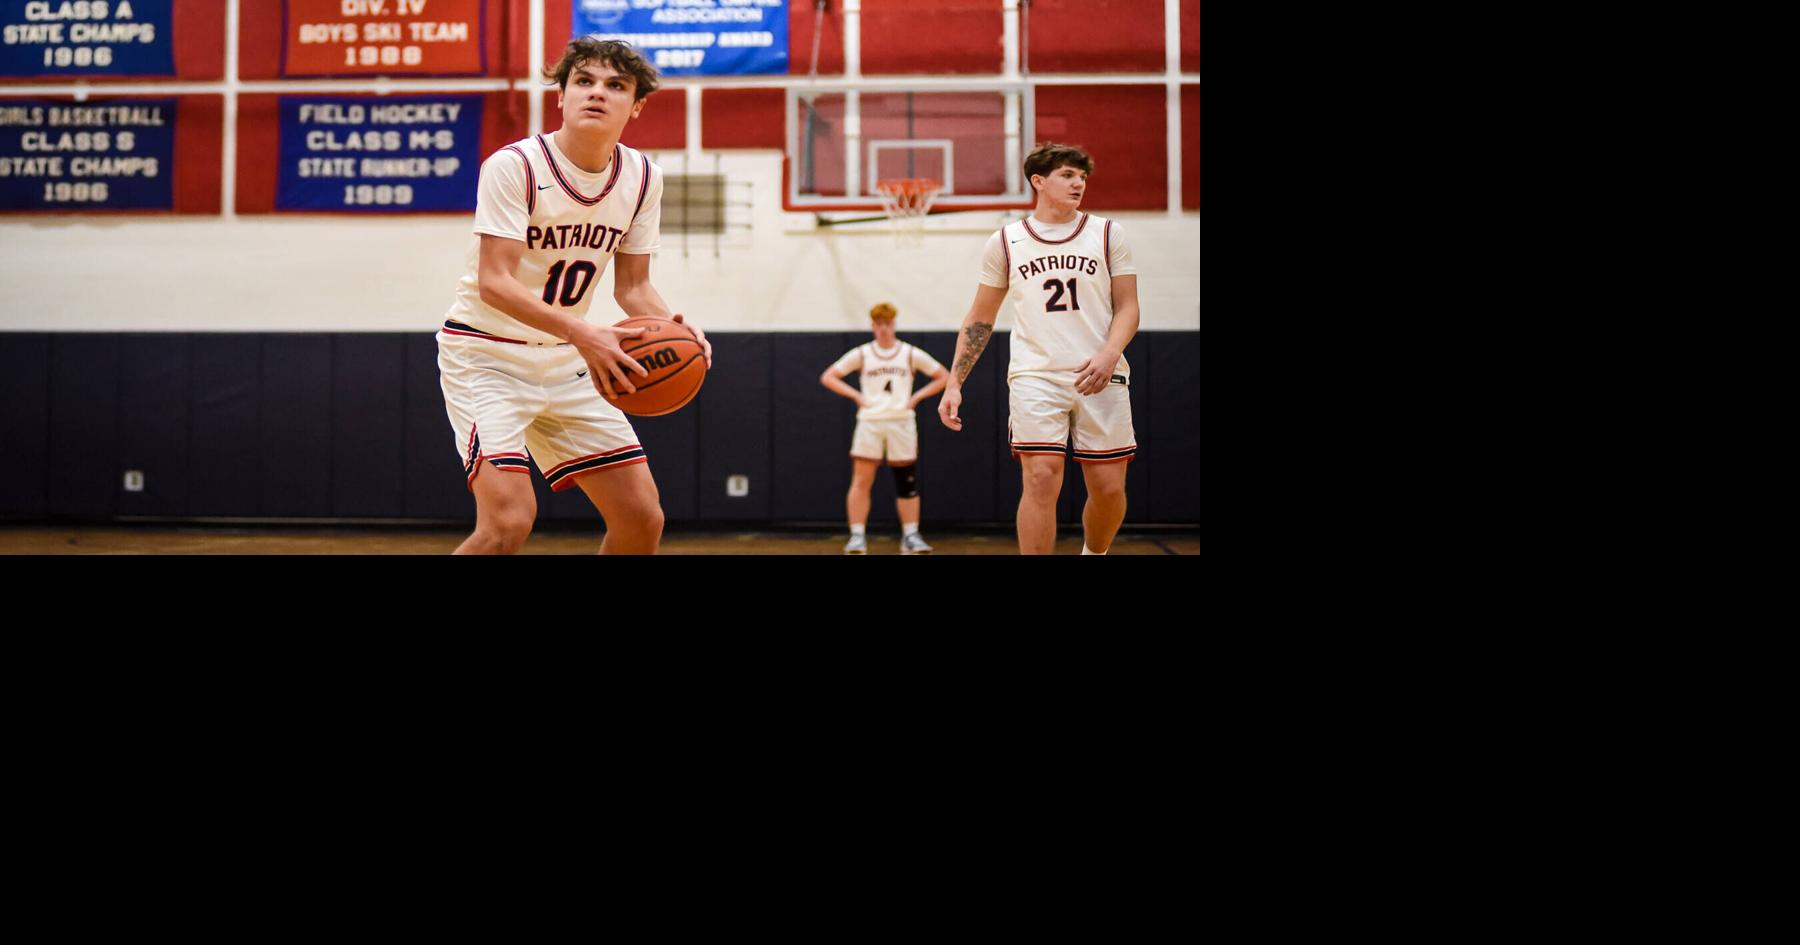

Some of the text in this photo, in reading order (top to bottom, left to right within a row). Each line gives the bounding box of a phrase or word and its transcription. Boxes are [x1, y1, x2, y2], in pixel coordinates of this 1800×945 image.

[25, 1, 133, 20] CLASS A
[651, 8, 763, 23] ASSOCIATION
[3, 23, 155, 44] STATE CHAMPS
[299, 22, 468, 43] BOYS SKI TEAM
[717, 31, 774, 47] AWARD
[44, 47, 113, 67] 1986
[344, 46, 422, 66] 1988
[48, 106, 163, 126] BASKETBALL
[299, 103, 461, 124] FIELD HOCKEY
[21, 131, 110, 151] CLASS
[306, 130, 454, 151] CLASS M-S
[0, 157, 159, 177] STATE CHAMPS
[298, 157, 460, 177] STATE RUNNER-UP
[1018, 254, 1099, 281] PATRIOTS
[542, 259, 597, 308] 10
[1043, 277, 1081, 313] 21
[883, 379, 893, 394] 4
